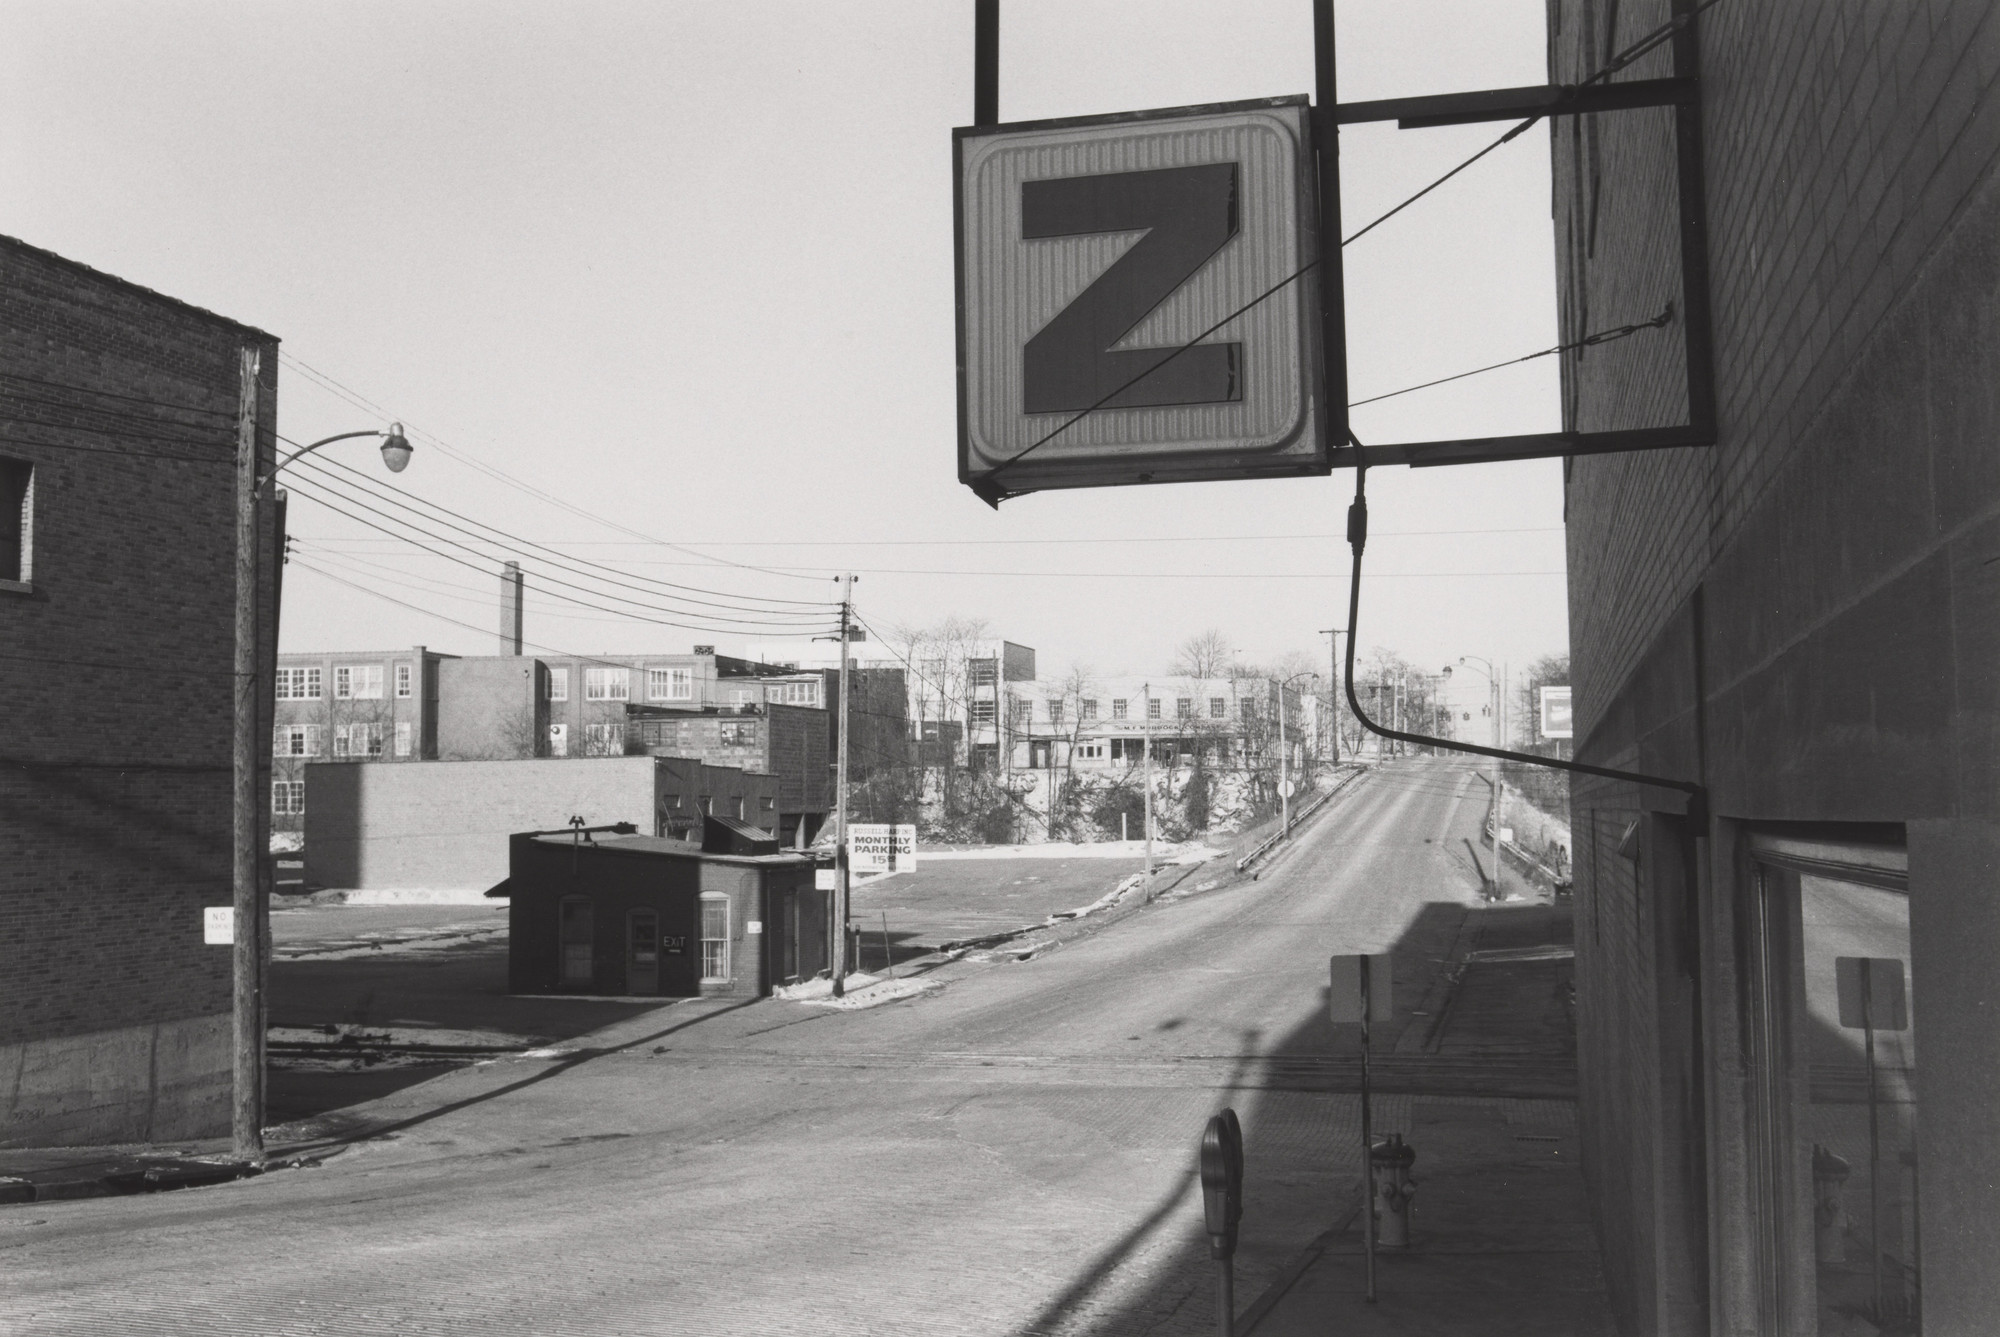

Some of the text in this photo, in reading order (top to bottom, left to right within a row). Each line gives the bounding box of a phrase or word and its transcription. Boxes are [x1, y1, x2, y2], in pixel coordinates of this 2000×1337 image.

[1022, 162, 1242, 414] Z
[854, 836, 911, 845] MONTHLY
[854, 845, 911, 855] PARKING
[212, 912, 227, 921] NO
[663, 936, 687, 947] EXIT
